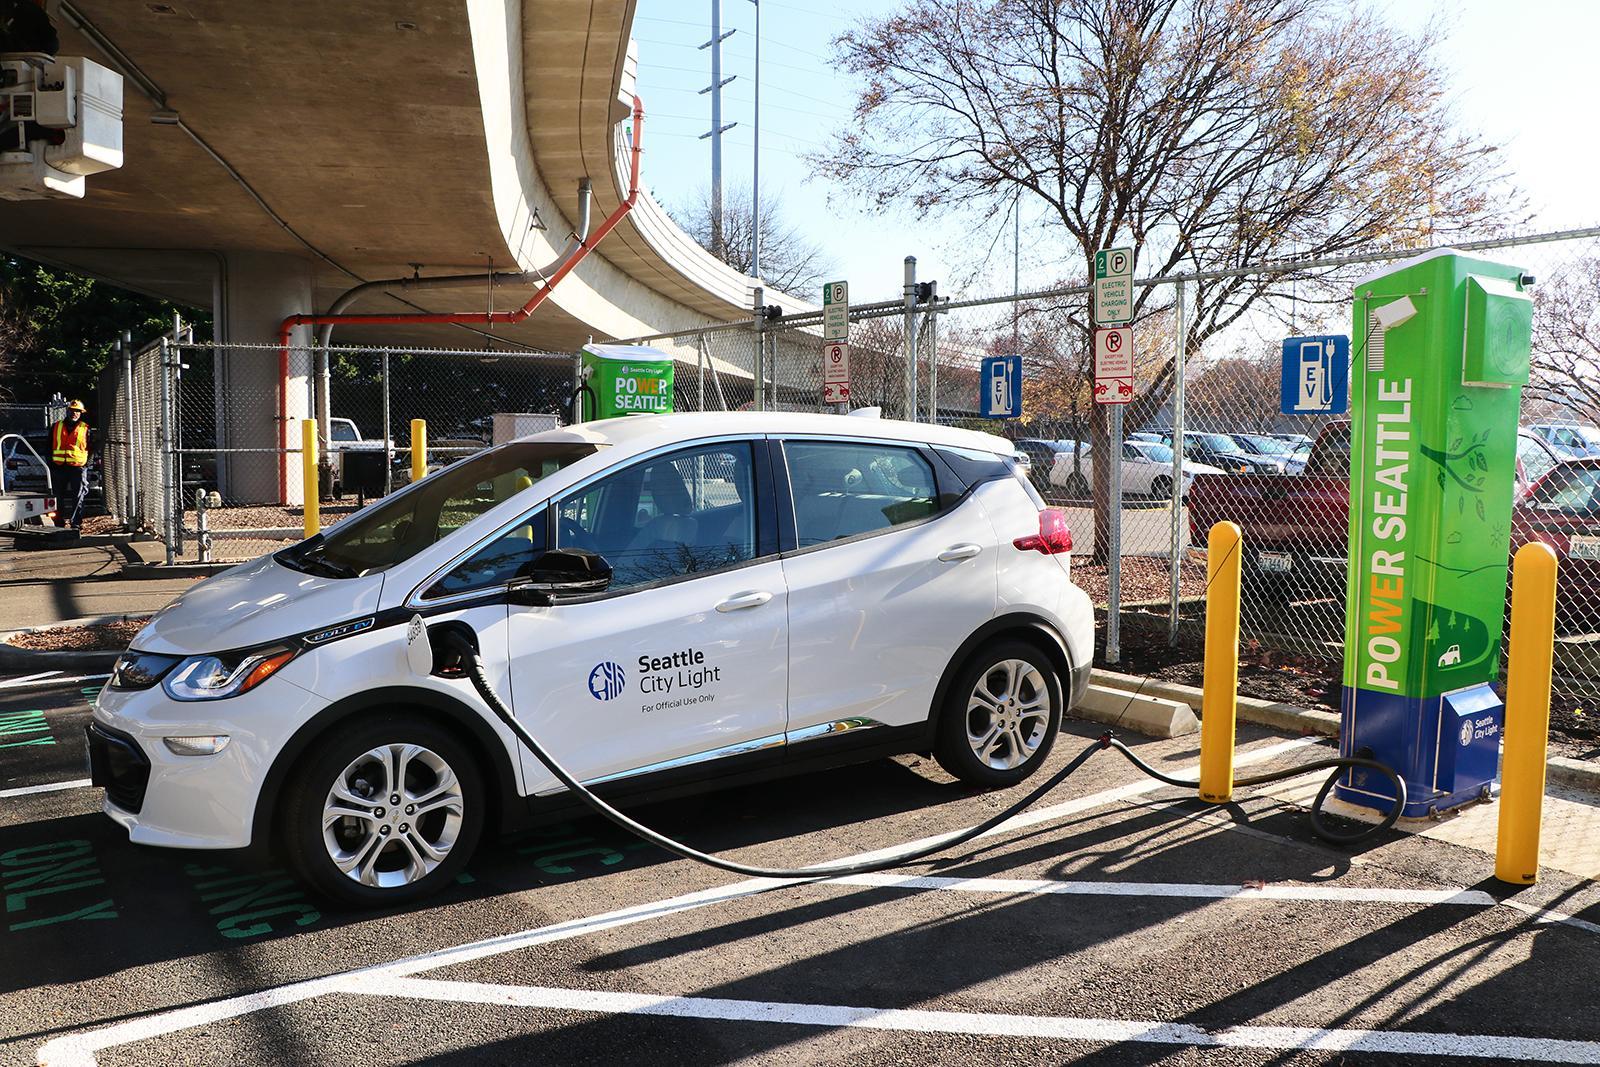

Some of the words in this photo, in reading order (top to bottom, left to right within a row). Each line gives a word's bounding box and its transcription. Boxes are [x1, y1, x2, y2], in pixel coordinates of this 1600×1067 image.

[1098, 257, 1105, 269] 2
[1114, 256, 1124, 270] P
[825, 288, 830, 298] 2
[1101, 280, 1126, 290] ELECTRIC
[1103, 290, 1125, 298] VEHICLE
[1101, 299, 1127, 307] CHARGING
[615, 377, 668, 395] POWER
[615, 394, 667, 410] SEATTLE
[1372, 378, 1412, 542] SEATTLE
[1366, 550, 1405, 690] POWER
[638, 648, 704, 674] Seattle
[640, 675, 674, 694] City
[678, 666, 721, 689] Light
[641, 704, 654, 713] For
[655, 698, 682, 711] Official
[683, 696, 698, 706] Use
[698, 693, 715, 703] Only
[1475, 715, 1494, 729] Seattle
[1474, 729, 1485, 739] City
[1485, 724, 1498, 736] Light
[0, 839, 119, 932] ONLY
